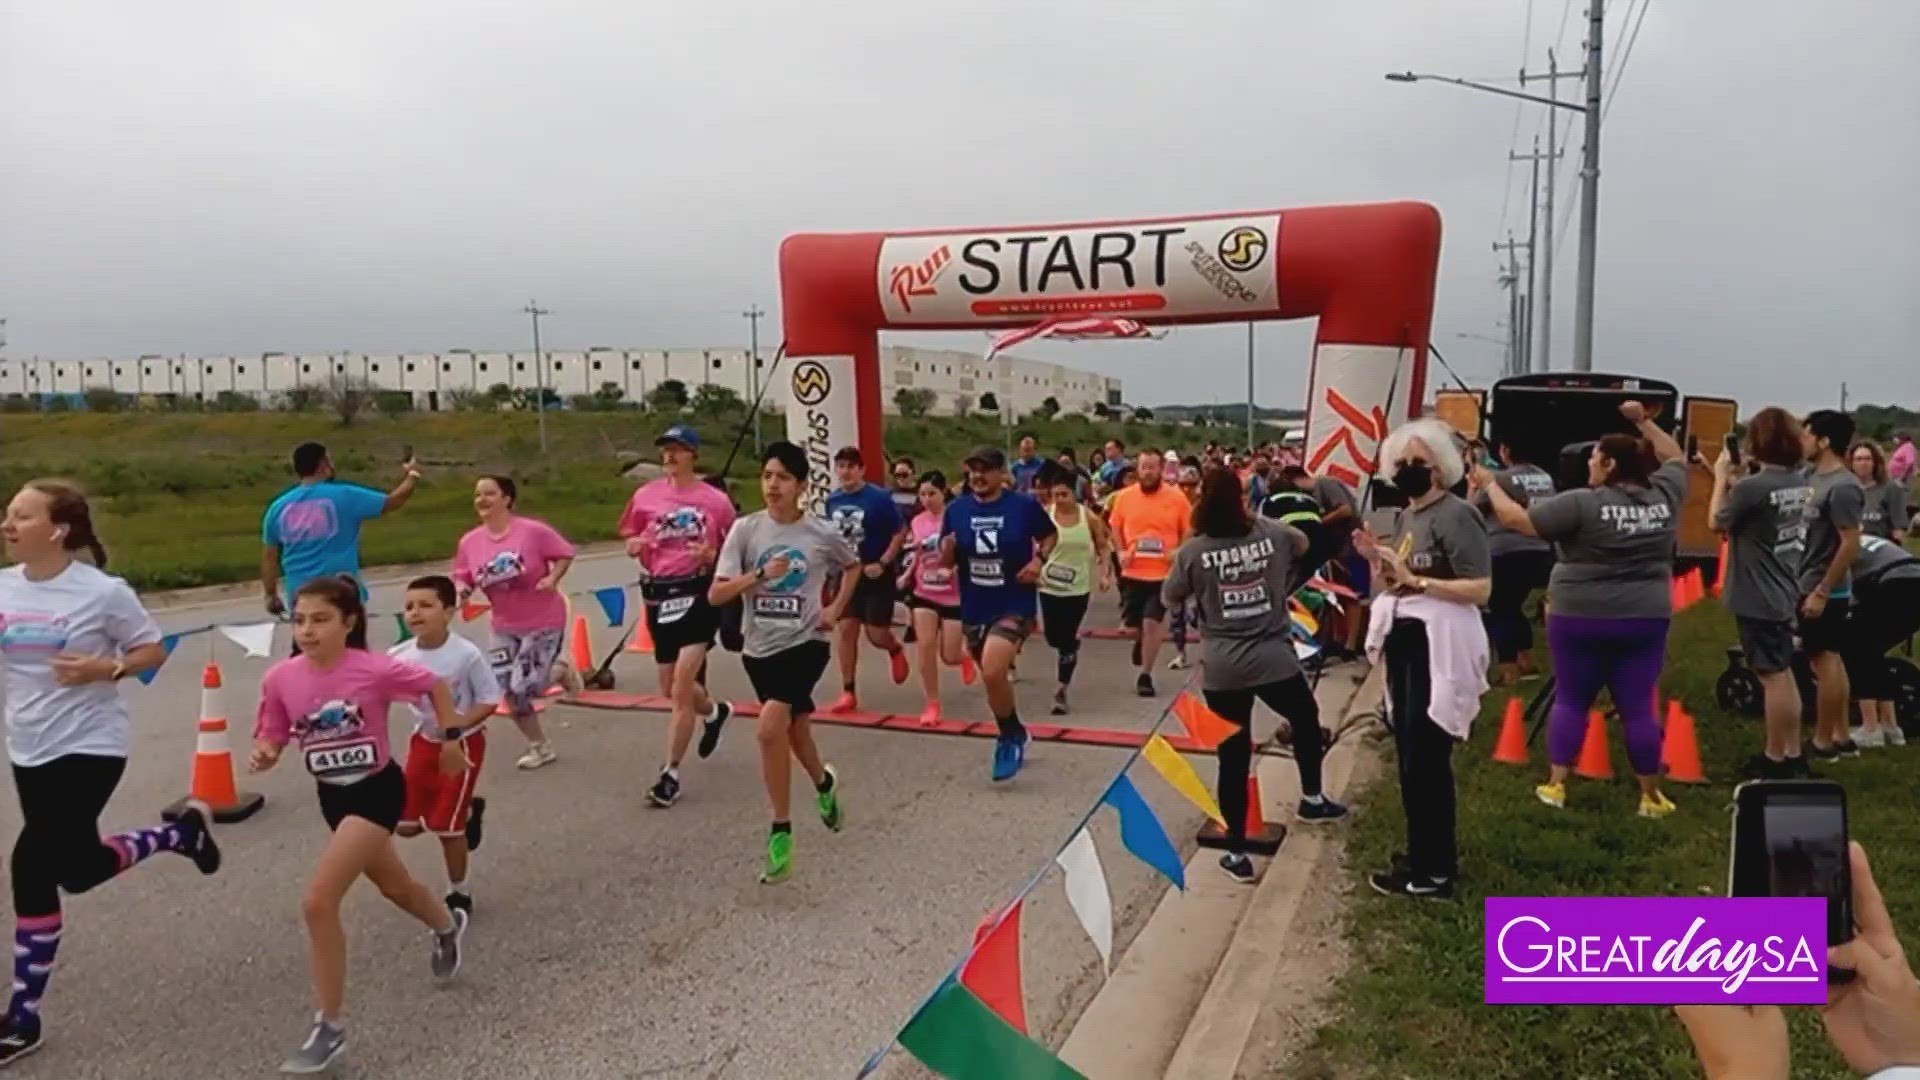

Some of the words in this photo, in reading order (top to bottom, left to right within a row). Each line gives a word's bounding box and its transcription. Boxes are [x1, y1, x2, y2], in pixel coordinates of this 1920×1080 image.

[957, 227, 1186, 295] START
[1201, 537, 1276, 570] STRONGER
[314, 748, 368, 767] 4160
